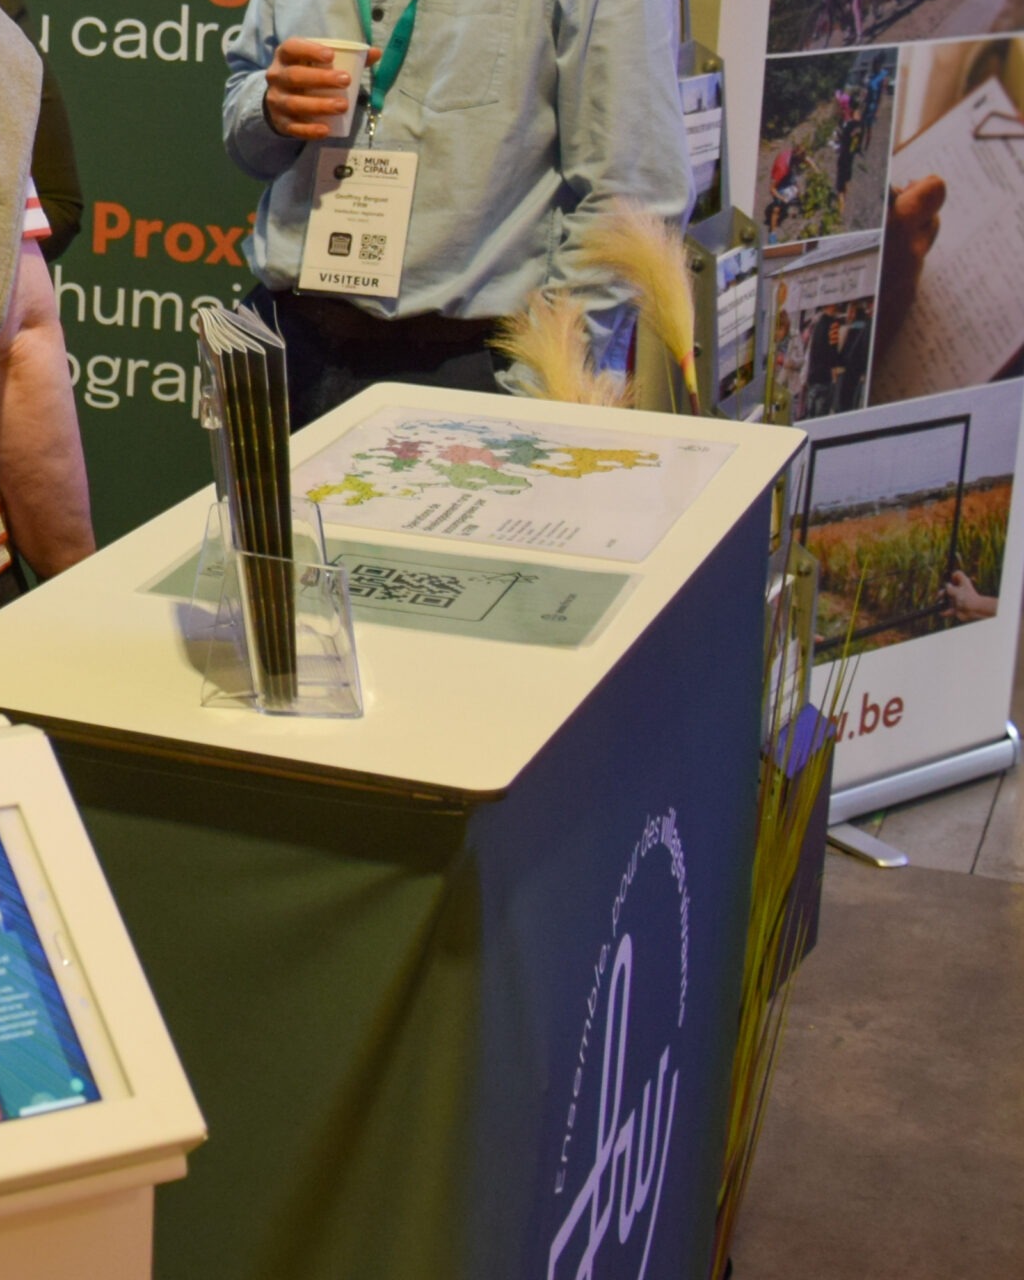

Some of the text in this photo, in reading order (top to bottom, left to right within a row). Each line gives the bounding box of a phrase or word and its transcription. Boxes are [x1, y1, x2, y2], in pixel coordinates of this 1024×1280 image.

[364, 157, 390, 167] MUNI
[363, 166, 399, 176] CIPALIA
[319, 272, 380, 288] VISITEUR
[612, 841, 640, 938] pour
[641, 814, 661, 857] des
